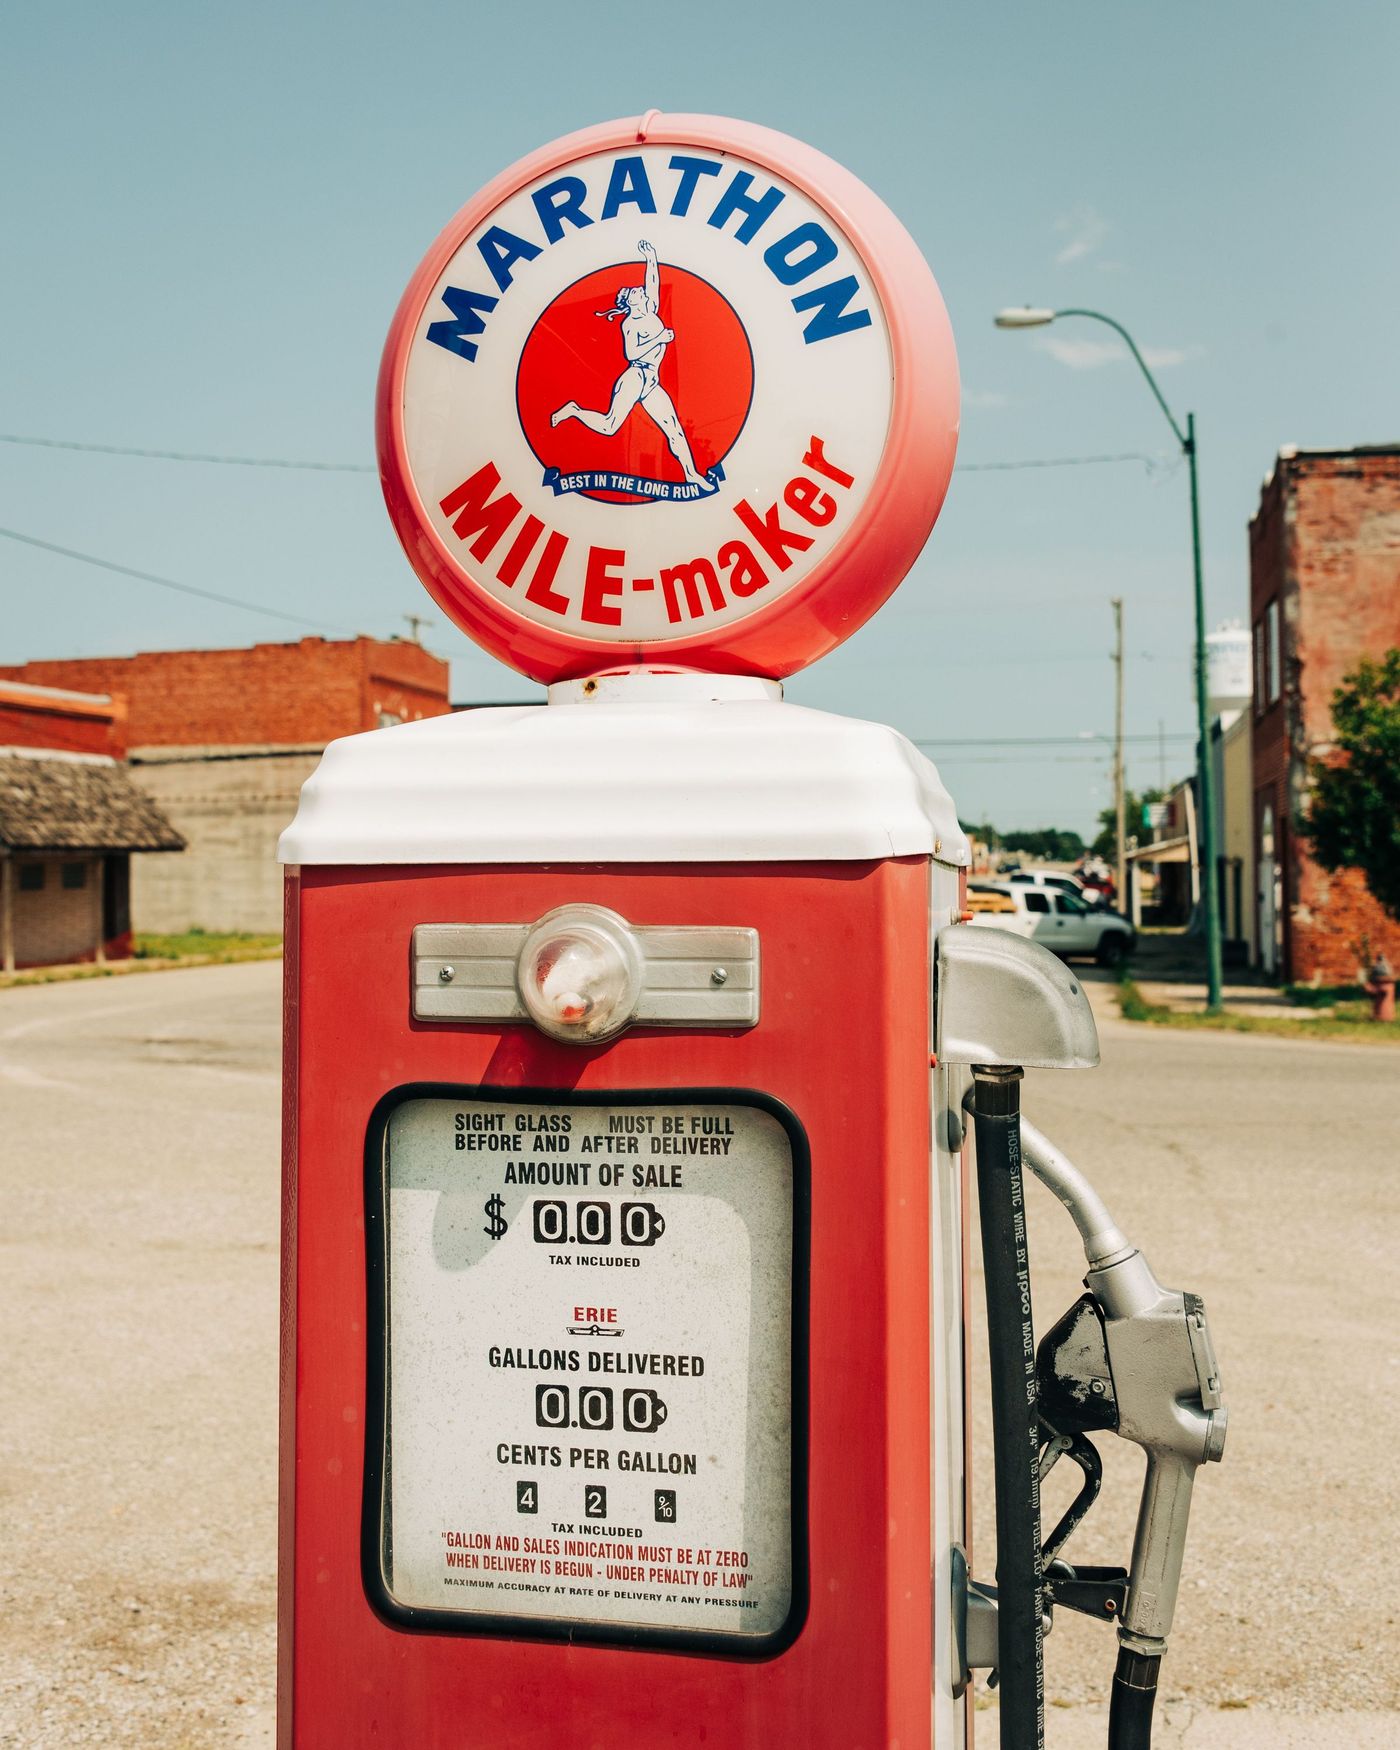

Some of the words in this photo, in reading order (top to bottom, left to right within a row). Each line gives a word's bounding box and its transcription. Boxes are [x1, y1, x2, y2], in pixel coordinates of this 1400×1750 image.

[426, 156, 873, 364] MARATHON
[560, 475, 591, 490] BEST
[595, 475, 607, 487] IN
[611, 476, 633, 490] THE
[637, 480, 668, 497] LONG
[673, 484, 700, 498] RUN
[439, 435, 855, 626] MILE-maker
[455, 1113, 505, 1132] SIGHT
[515, 1114, 572, 1132] GLASS
[609, 1116, 654, 1134] MUST
[662, 1116, 684, 1134] BE
[692, 1117, 734, 1135] FULL
[455, 1134, 522, 1152] BEFORE
[533, 1135, 570, 1152] AND
[581, 1136, 639, 1153] AFTER
[651, 1137, 731, 1155] DELIVERY
[504, 1162, 591, 1186] AMOUNT
[599, 1164, 624, 1186] OF
[632, 1165, 682, 1188] SALE
[1007, 1130, 1022, 1207] HOSE-STATIC
[484, 1193, 508, 1240] $
[1014, 1212, 1024, 1243] WIRE
[549, 1255, 572, 1266] TAX
[577, 1256, 640, 1268] INCLUDED
[1016, 1248, 1026, 1264] BY
[574, 1307, 617, 1323] ERIE
[1022, 1321, 1032, 1357] MADE
[489, 1347, 580, 1372] GALLONS
[588, 1351, 705, 1377] DELIVERED
[1025, 1361, 1034, 1375] IN
[1026, 1380, 1037, 1405] USA
[496, 1444, 562, 1467] CENTS
[570, 1447, 609, 1469] PER
[617, 1450, 697, 1475] GALLON
[519, 1484, 536, 1510] 4
[587, 1488, 604, 1516] 2
[552, 1523, 574, 1534] TAX
[579, 1524, 643, 1538] INCLUDED
[442, 1532, 490, 1549] "GALLON
[496, 1536, 519, 1552] AND
[524, 1538, 560, 1554] SALES
[564, 1541, 633, 1560] INDICATION
[638, 1546, 672, 1562] MUST
[678, 1549, 692, 1564] BE
[697, 1550, 711, 1565] AT
[716, 1551, 748, 1567] ZERO
[446, 1552, 479, 1568] WHEN
[483, 1555, 536, 1573] DELIVERY
[541, 1560, 550, 1574] IS
[555, 1561, 592, 1577] BEGUN
[607, 1565, 644, 1582] UNDER
[650, 1568, 699, 1585] PENALTY
[704, 1571, 718, 1586] OF
[723, 1573, 752, 1588] LAW"
[444, 1578, 494, 1588] MAXIMUM
[498, 1582, 550, 1592] ACCURACY
[570, 1588, 594, 1596] RATE
[614, 1591, 662, 1601] DELIVERY
[705, 1598, 758, 1608] PRESSURE
